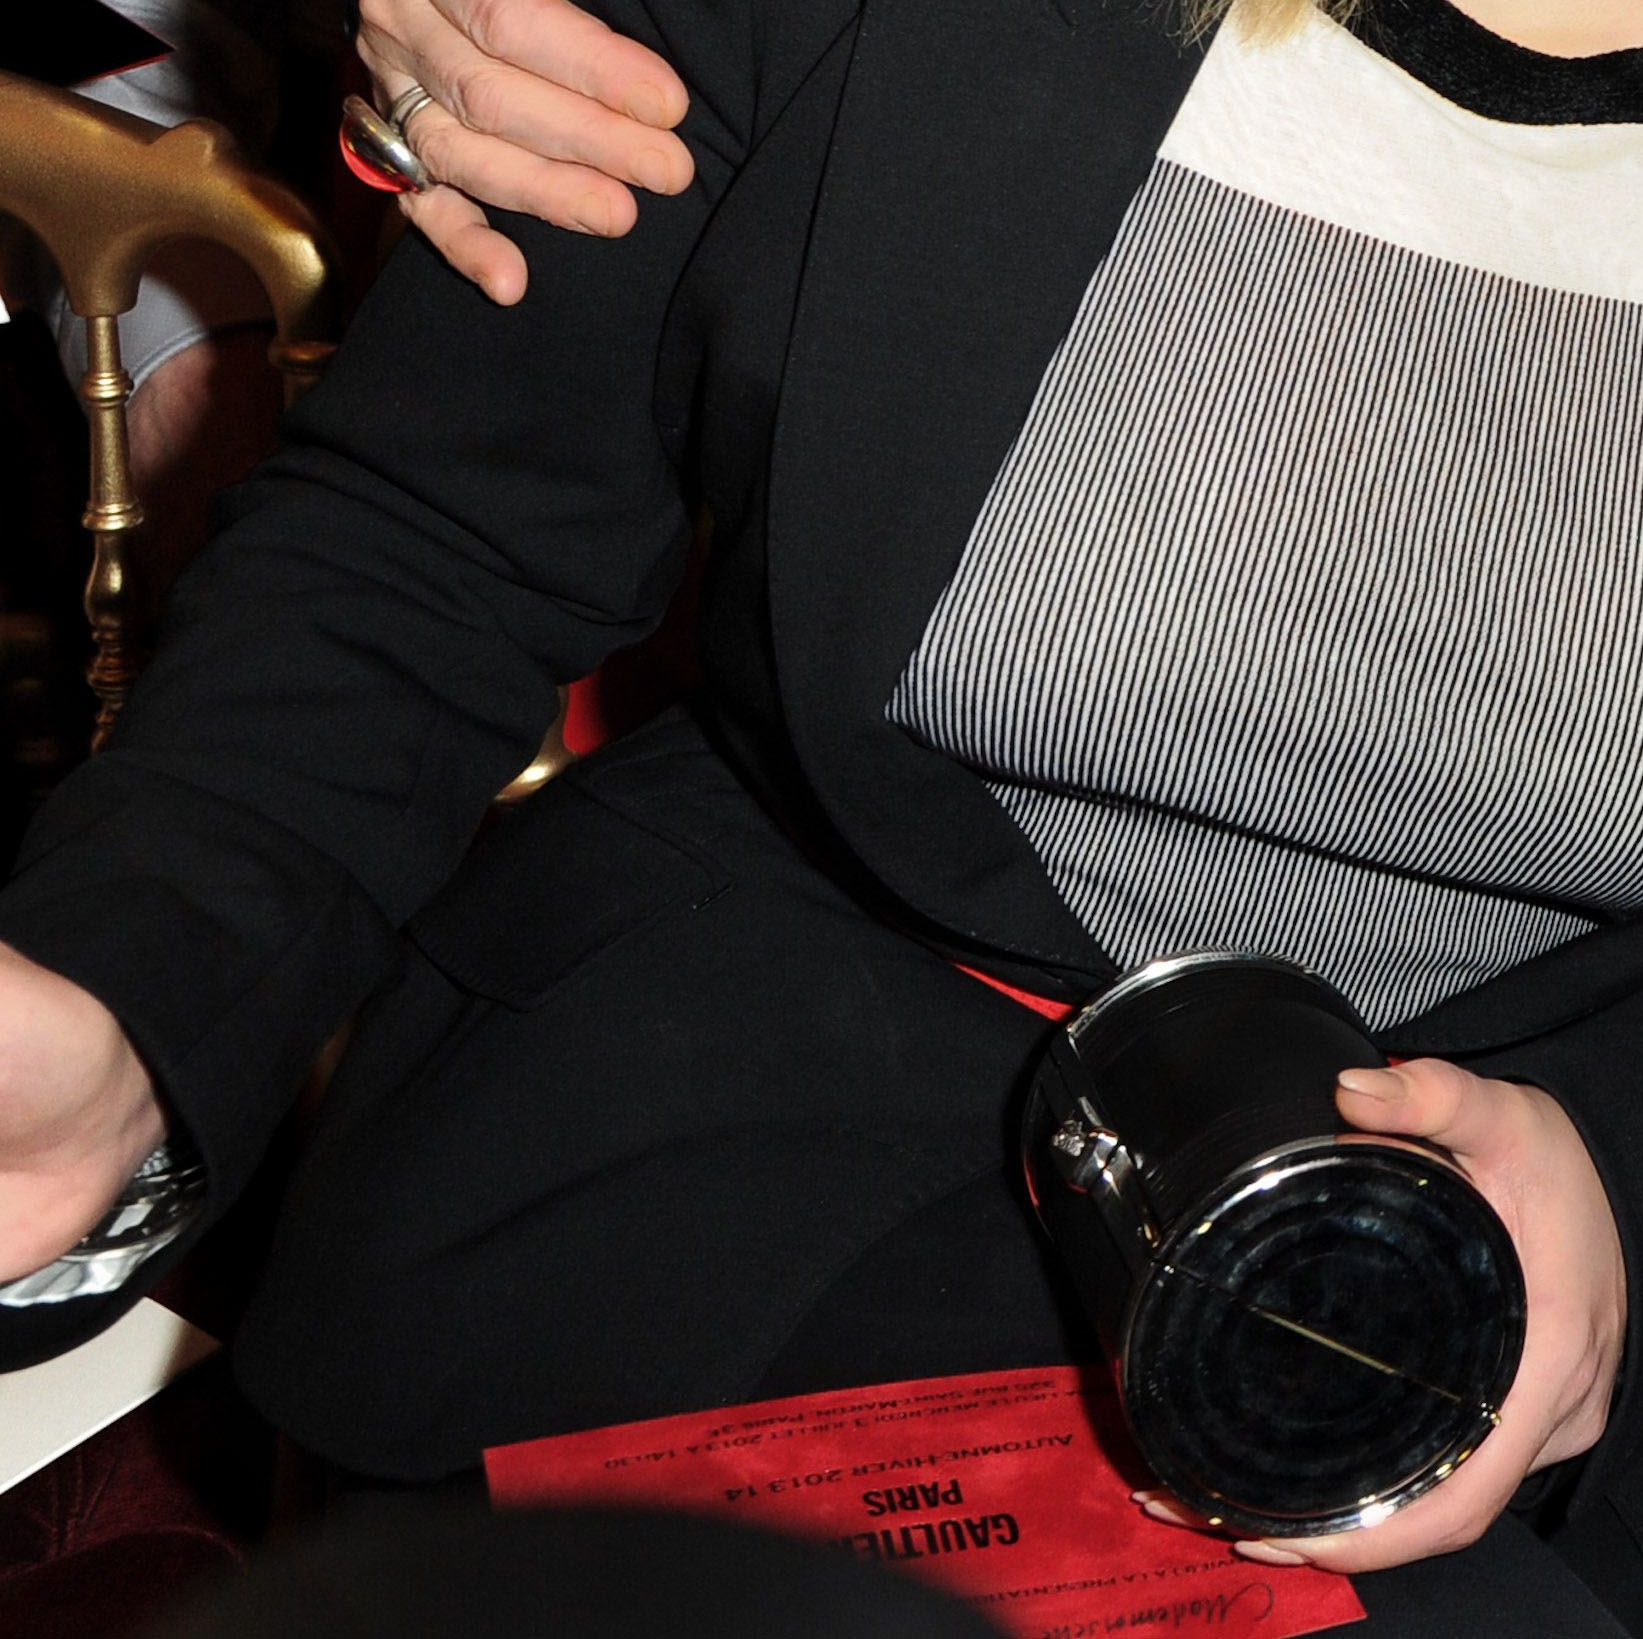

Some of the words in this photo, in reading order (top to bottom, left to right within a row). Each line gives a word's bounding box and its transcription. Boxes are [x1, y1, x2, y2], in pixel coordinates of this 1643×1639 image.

[875, 1401, 979, 1424] MERCREDI
[707, 1433, 761, 1451] 2013
[862, 1479, 964, 1517] PARIS
